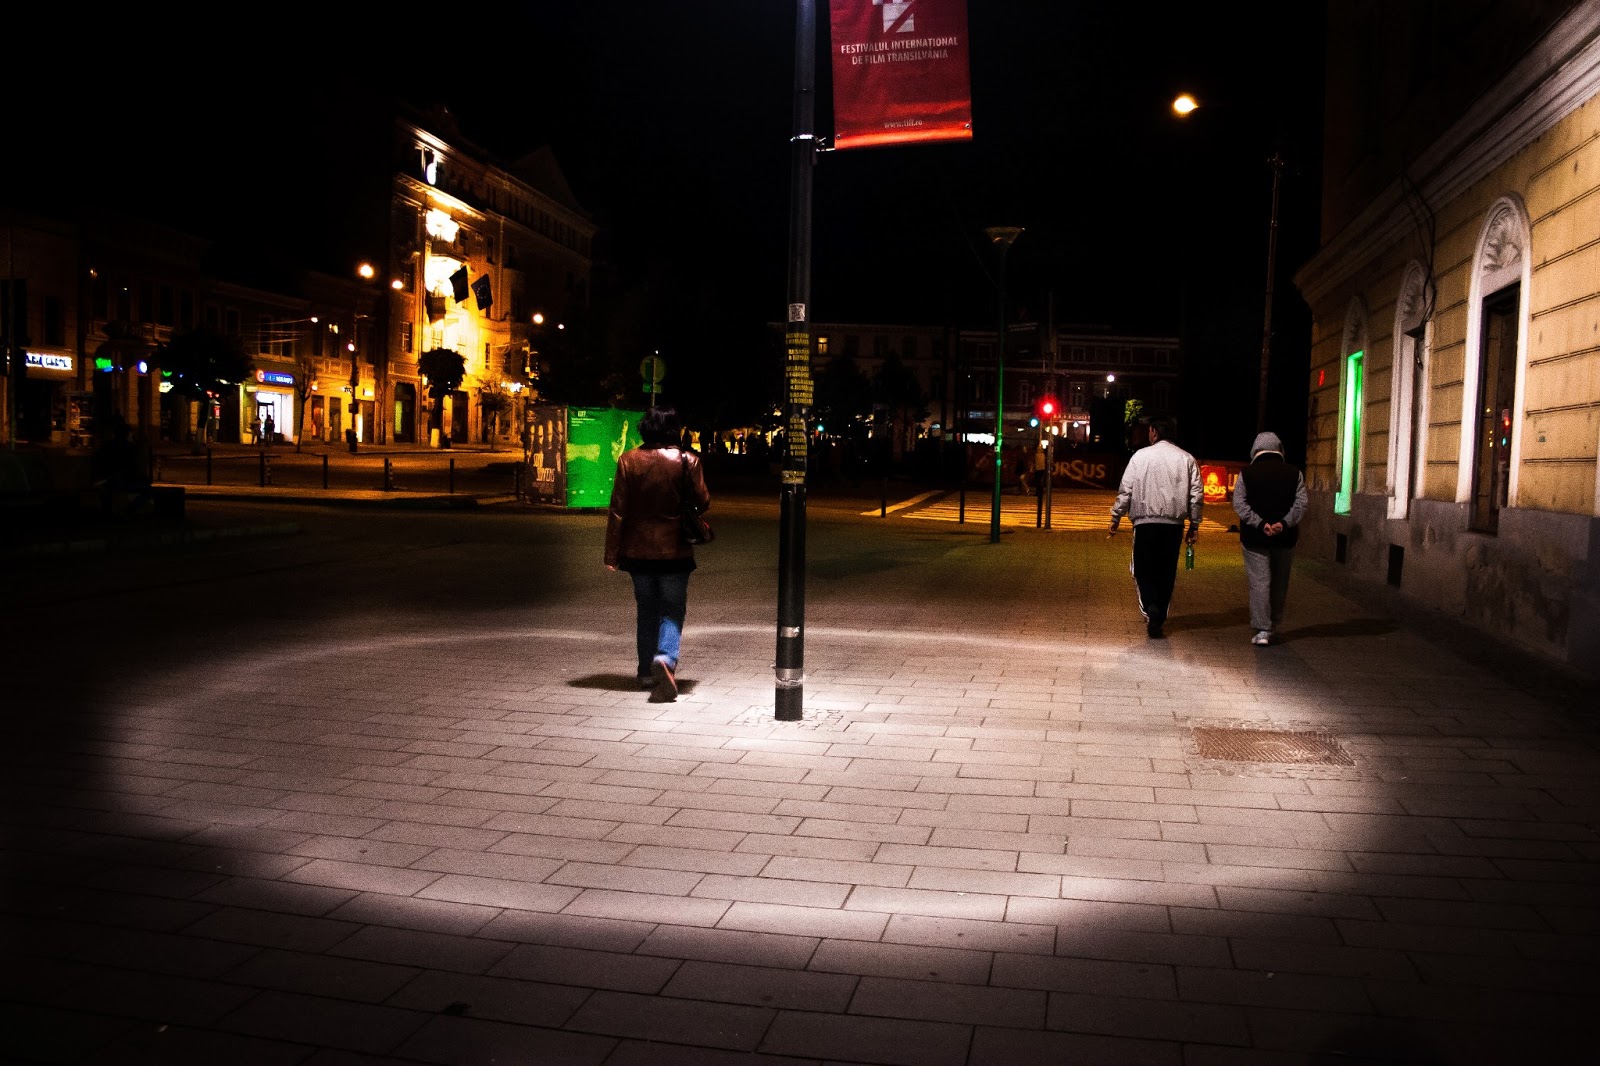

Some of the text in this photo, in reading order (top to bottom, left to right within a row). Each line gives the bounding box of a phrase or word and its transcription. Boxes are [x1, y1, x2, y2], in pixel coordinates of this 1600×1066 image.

[841, 42, 889, 54] FESTIVALUL
[852, 49, 949, 65] DE FILM TRANSILVANIA
[1203, 484, 1227, 496] RSUS
